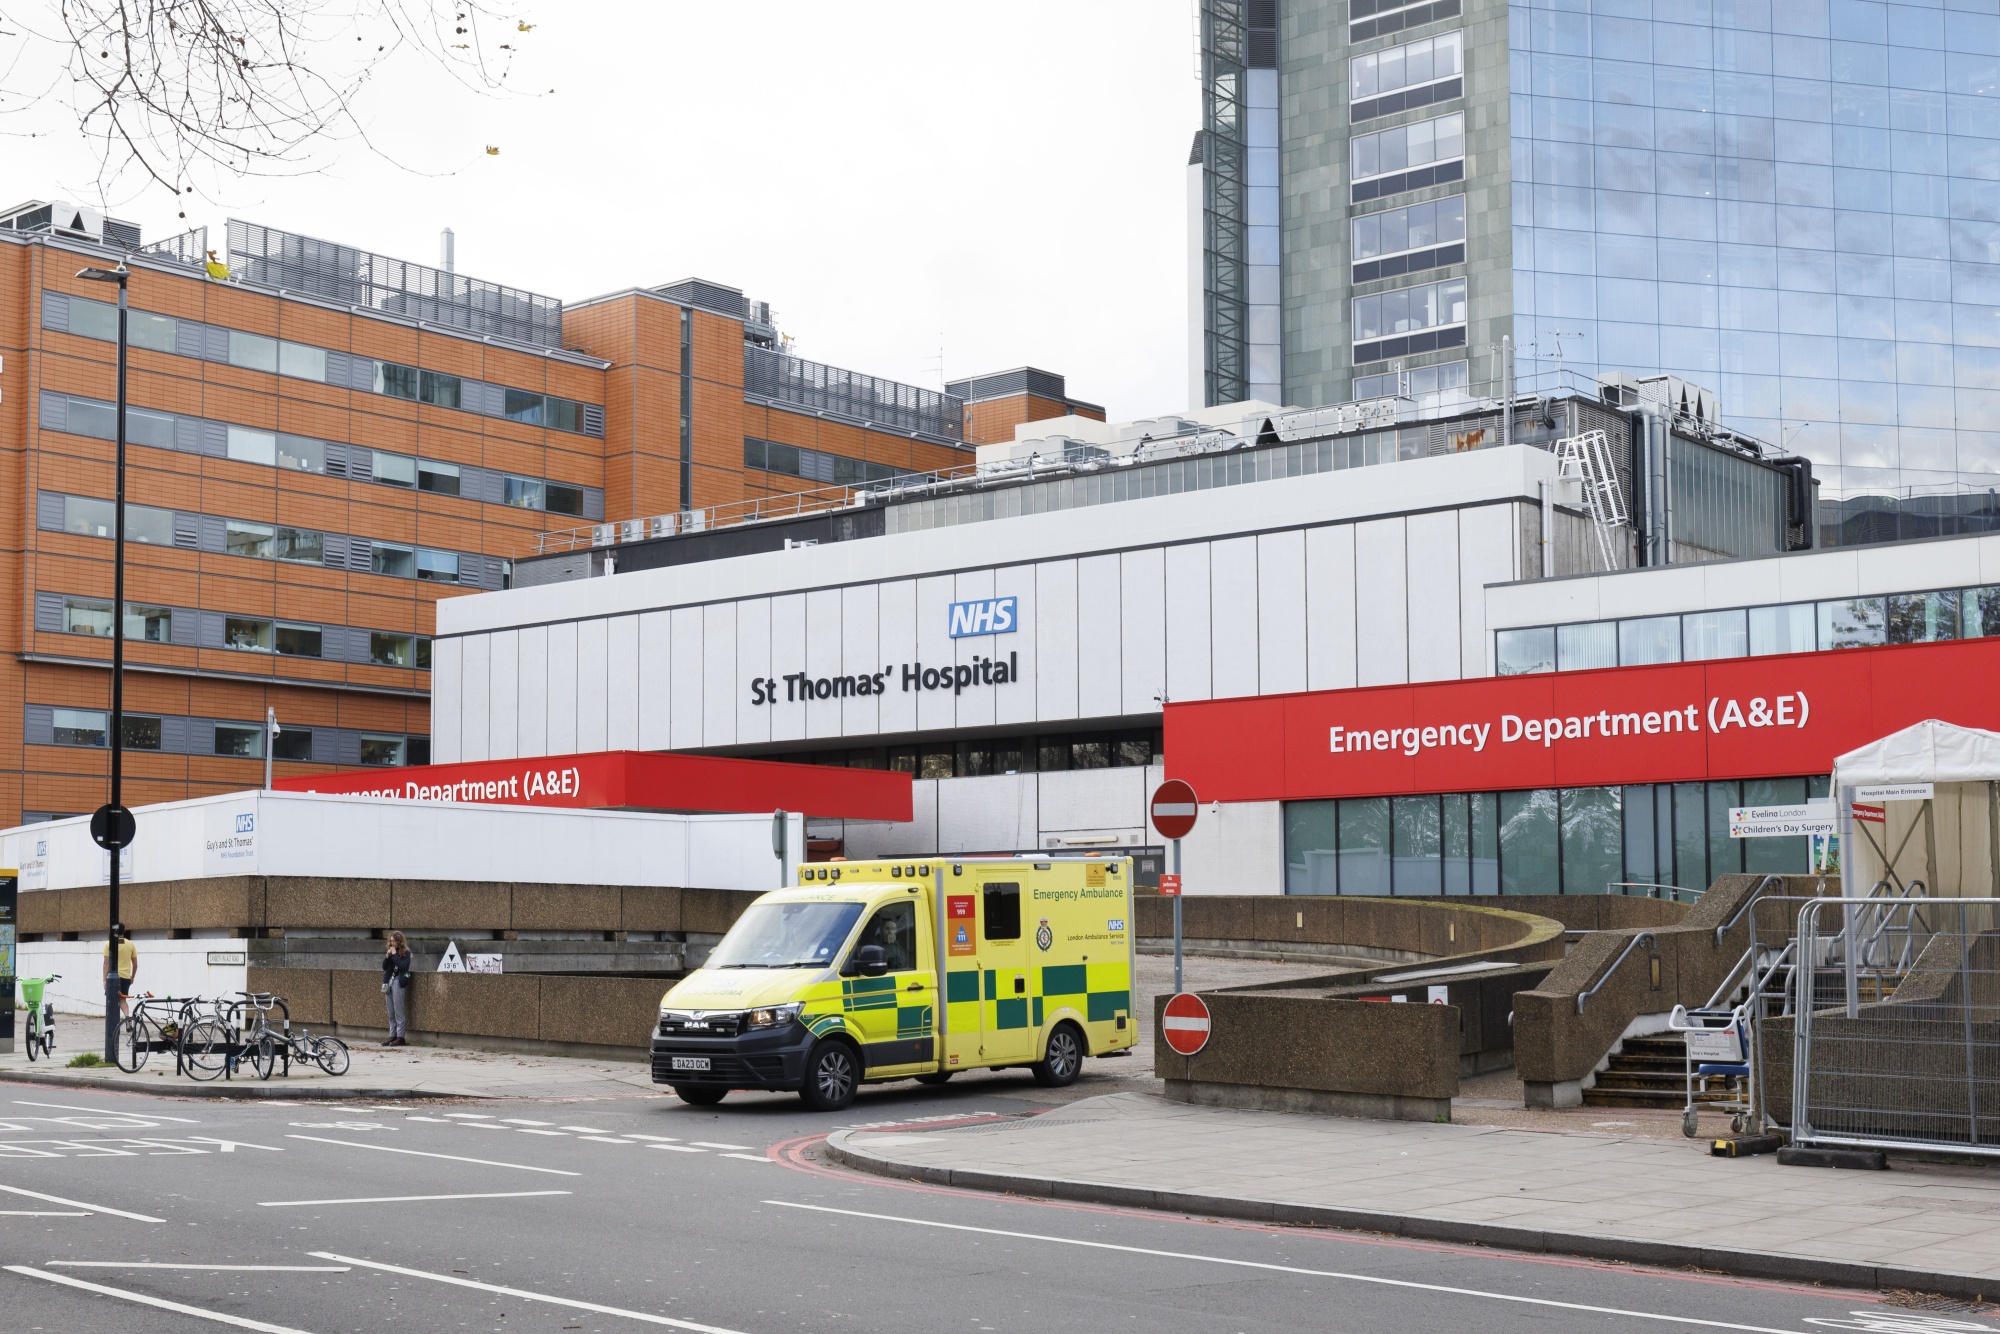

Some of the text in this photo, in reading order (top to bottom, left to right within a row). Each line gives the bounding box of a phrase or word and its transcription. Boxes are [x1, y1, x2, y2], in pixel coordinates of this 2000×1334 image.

[950, 599, 1013, 635] NHS
[751, 677, 777, 706] St
[902, 651, 1017, 696] Hospital
[1329, 692, 1810, 757] Emergency Department (A&E)
[406, 767, 580, 802] Department (A&E)
[1861, 787, 1927, 797] Hospital Main Entrance
[1751, 808, 1807, 819] Evelina London
[236, 814, 253, 832] NHS
[1784, 824, 1800, 836] Day
[1801, 822, 1834, 835] Surgery
[219, 838, 228, 849] and
[228, 838, 234, 848] St
[1033, 888, 1124, 902] Emergency Ambulance
[1108, 920, 1123, 930] NHS
[1084, 933, 1109, 941] Ambulance
[1109, 932, 1124, 940] Service
[684, 1021, 709, 1029] MAN
[676, 1059, 695, 1069] DA23
